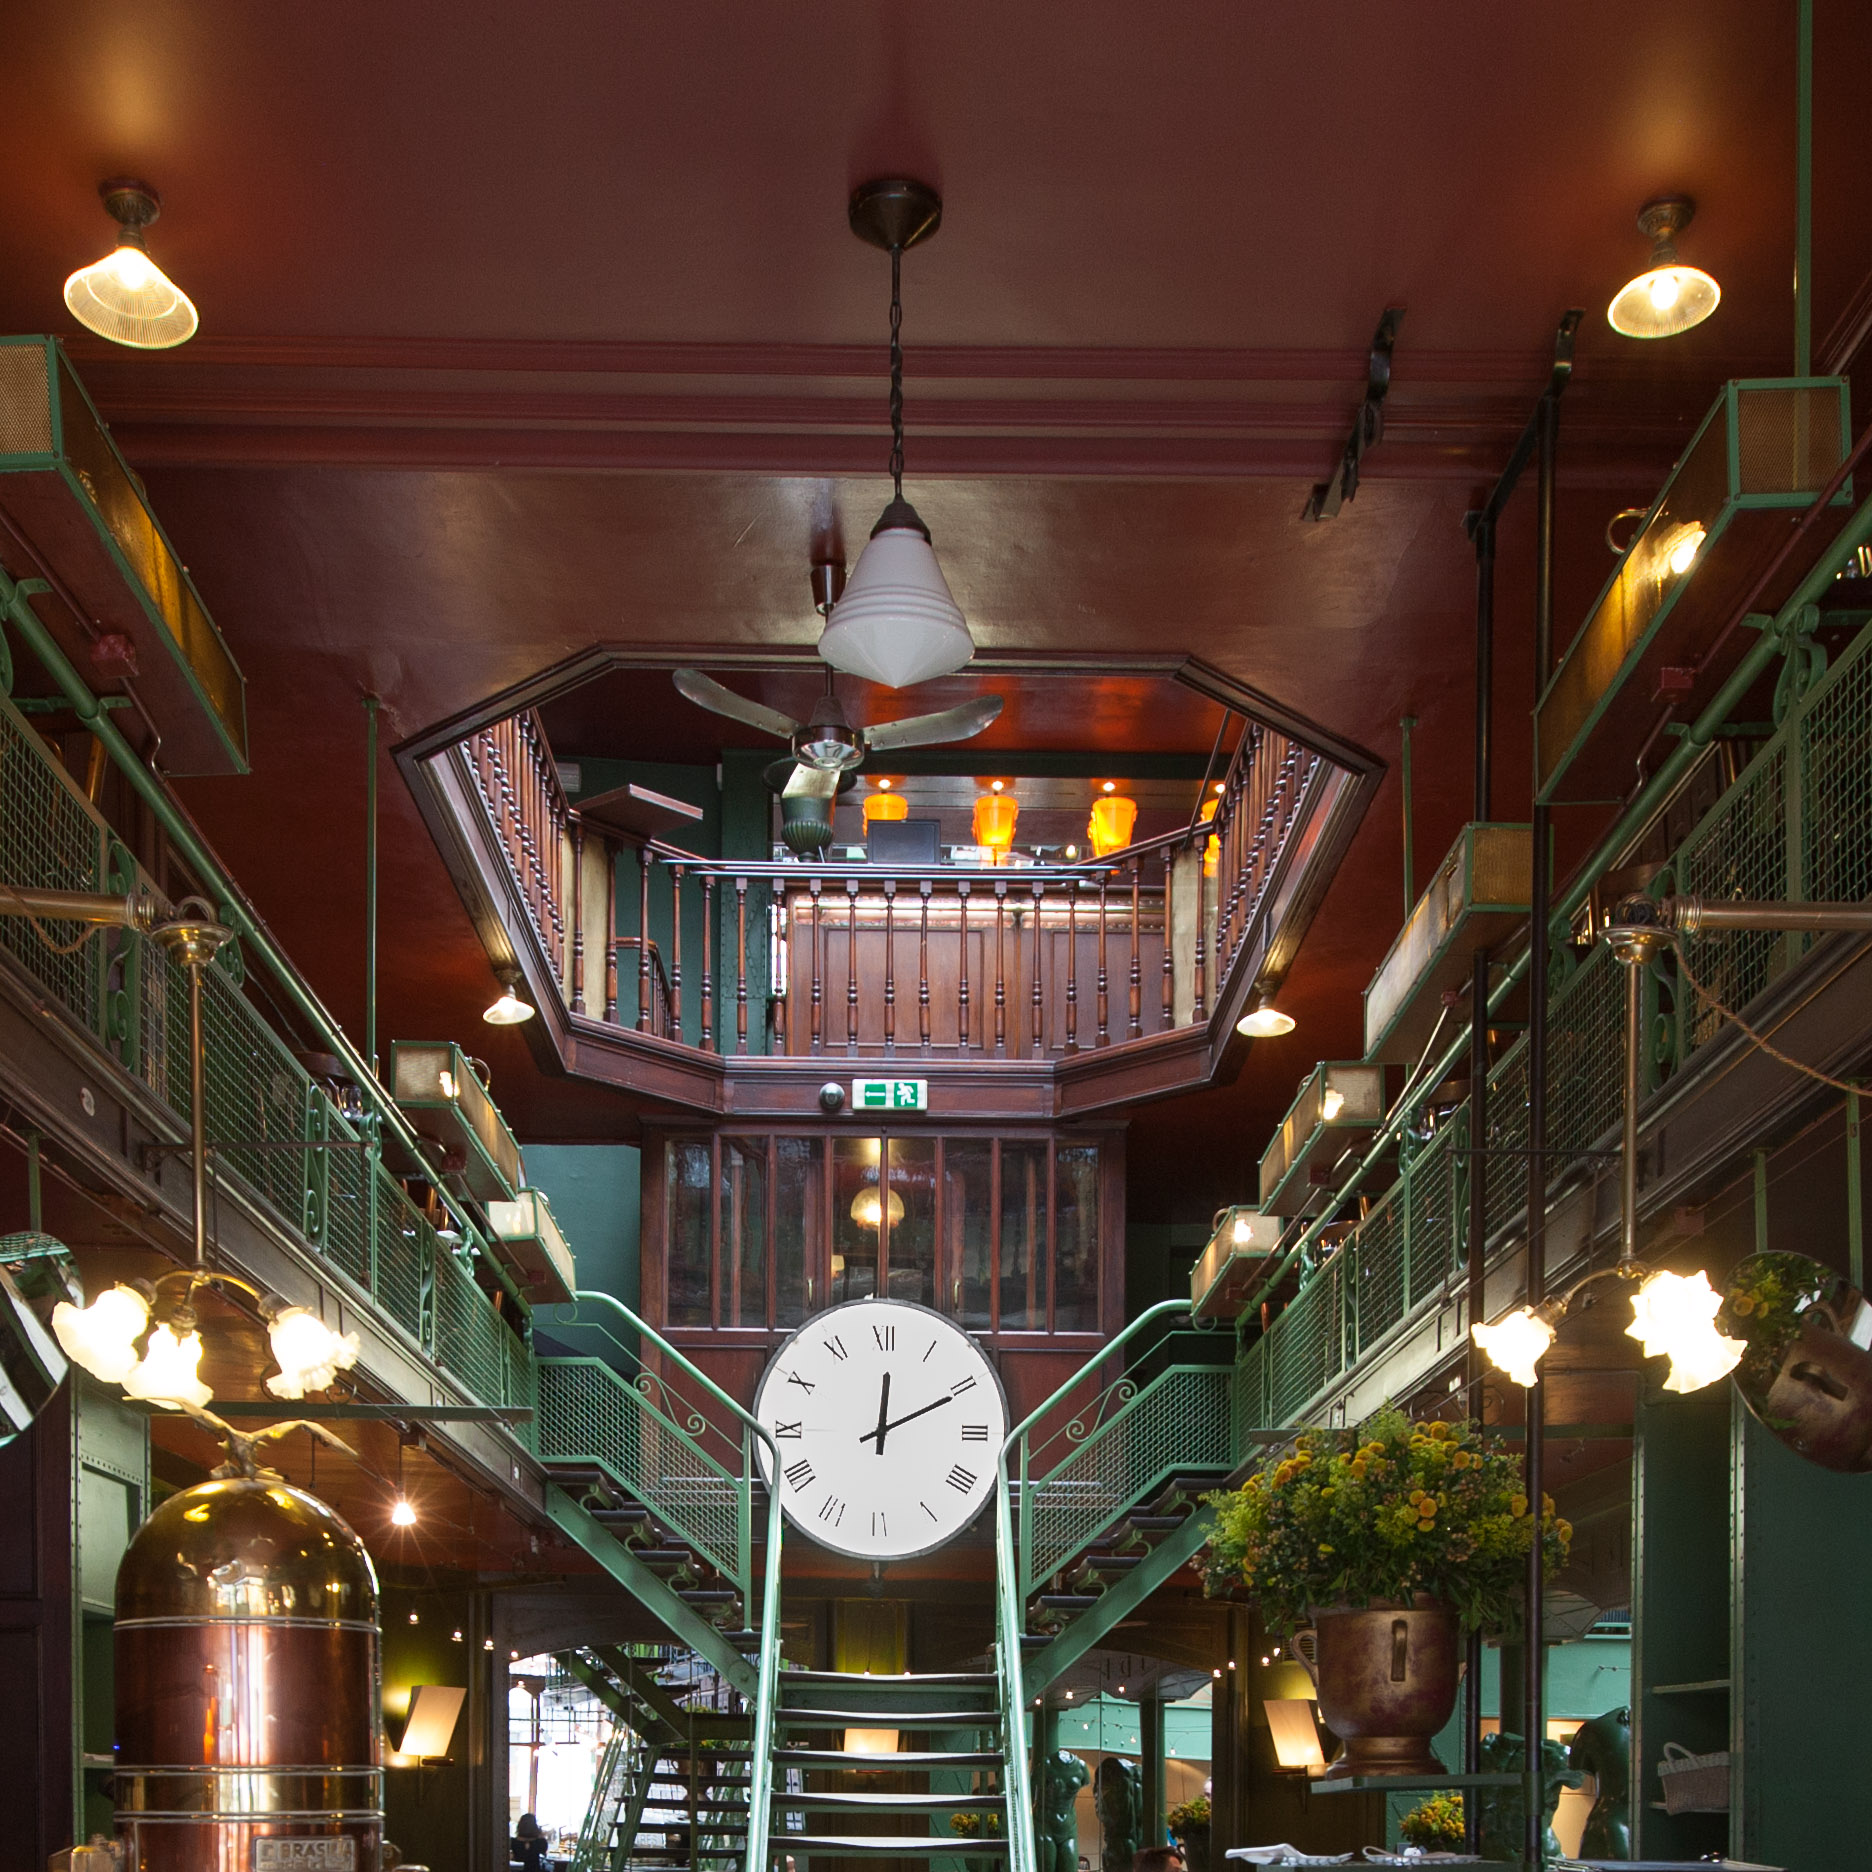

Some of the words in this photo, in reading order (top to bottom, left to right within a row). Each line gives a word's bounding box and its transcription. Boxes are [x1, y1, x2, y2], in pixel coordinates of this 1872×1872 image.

[872, 1325, 895, 1351] XII
[787, 1370, 816, 1396] X
[950, 1374, 978, 1397] II
[775, 1420, 803, 1440] IX
[961, 1424, 989, 1442] III
